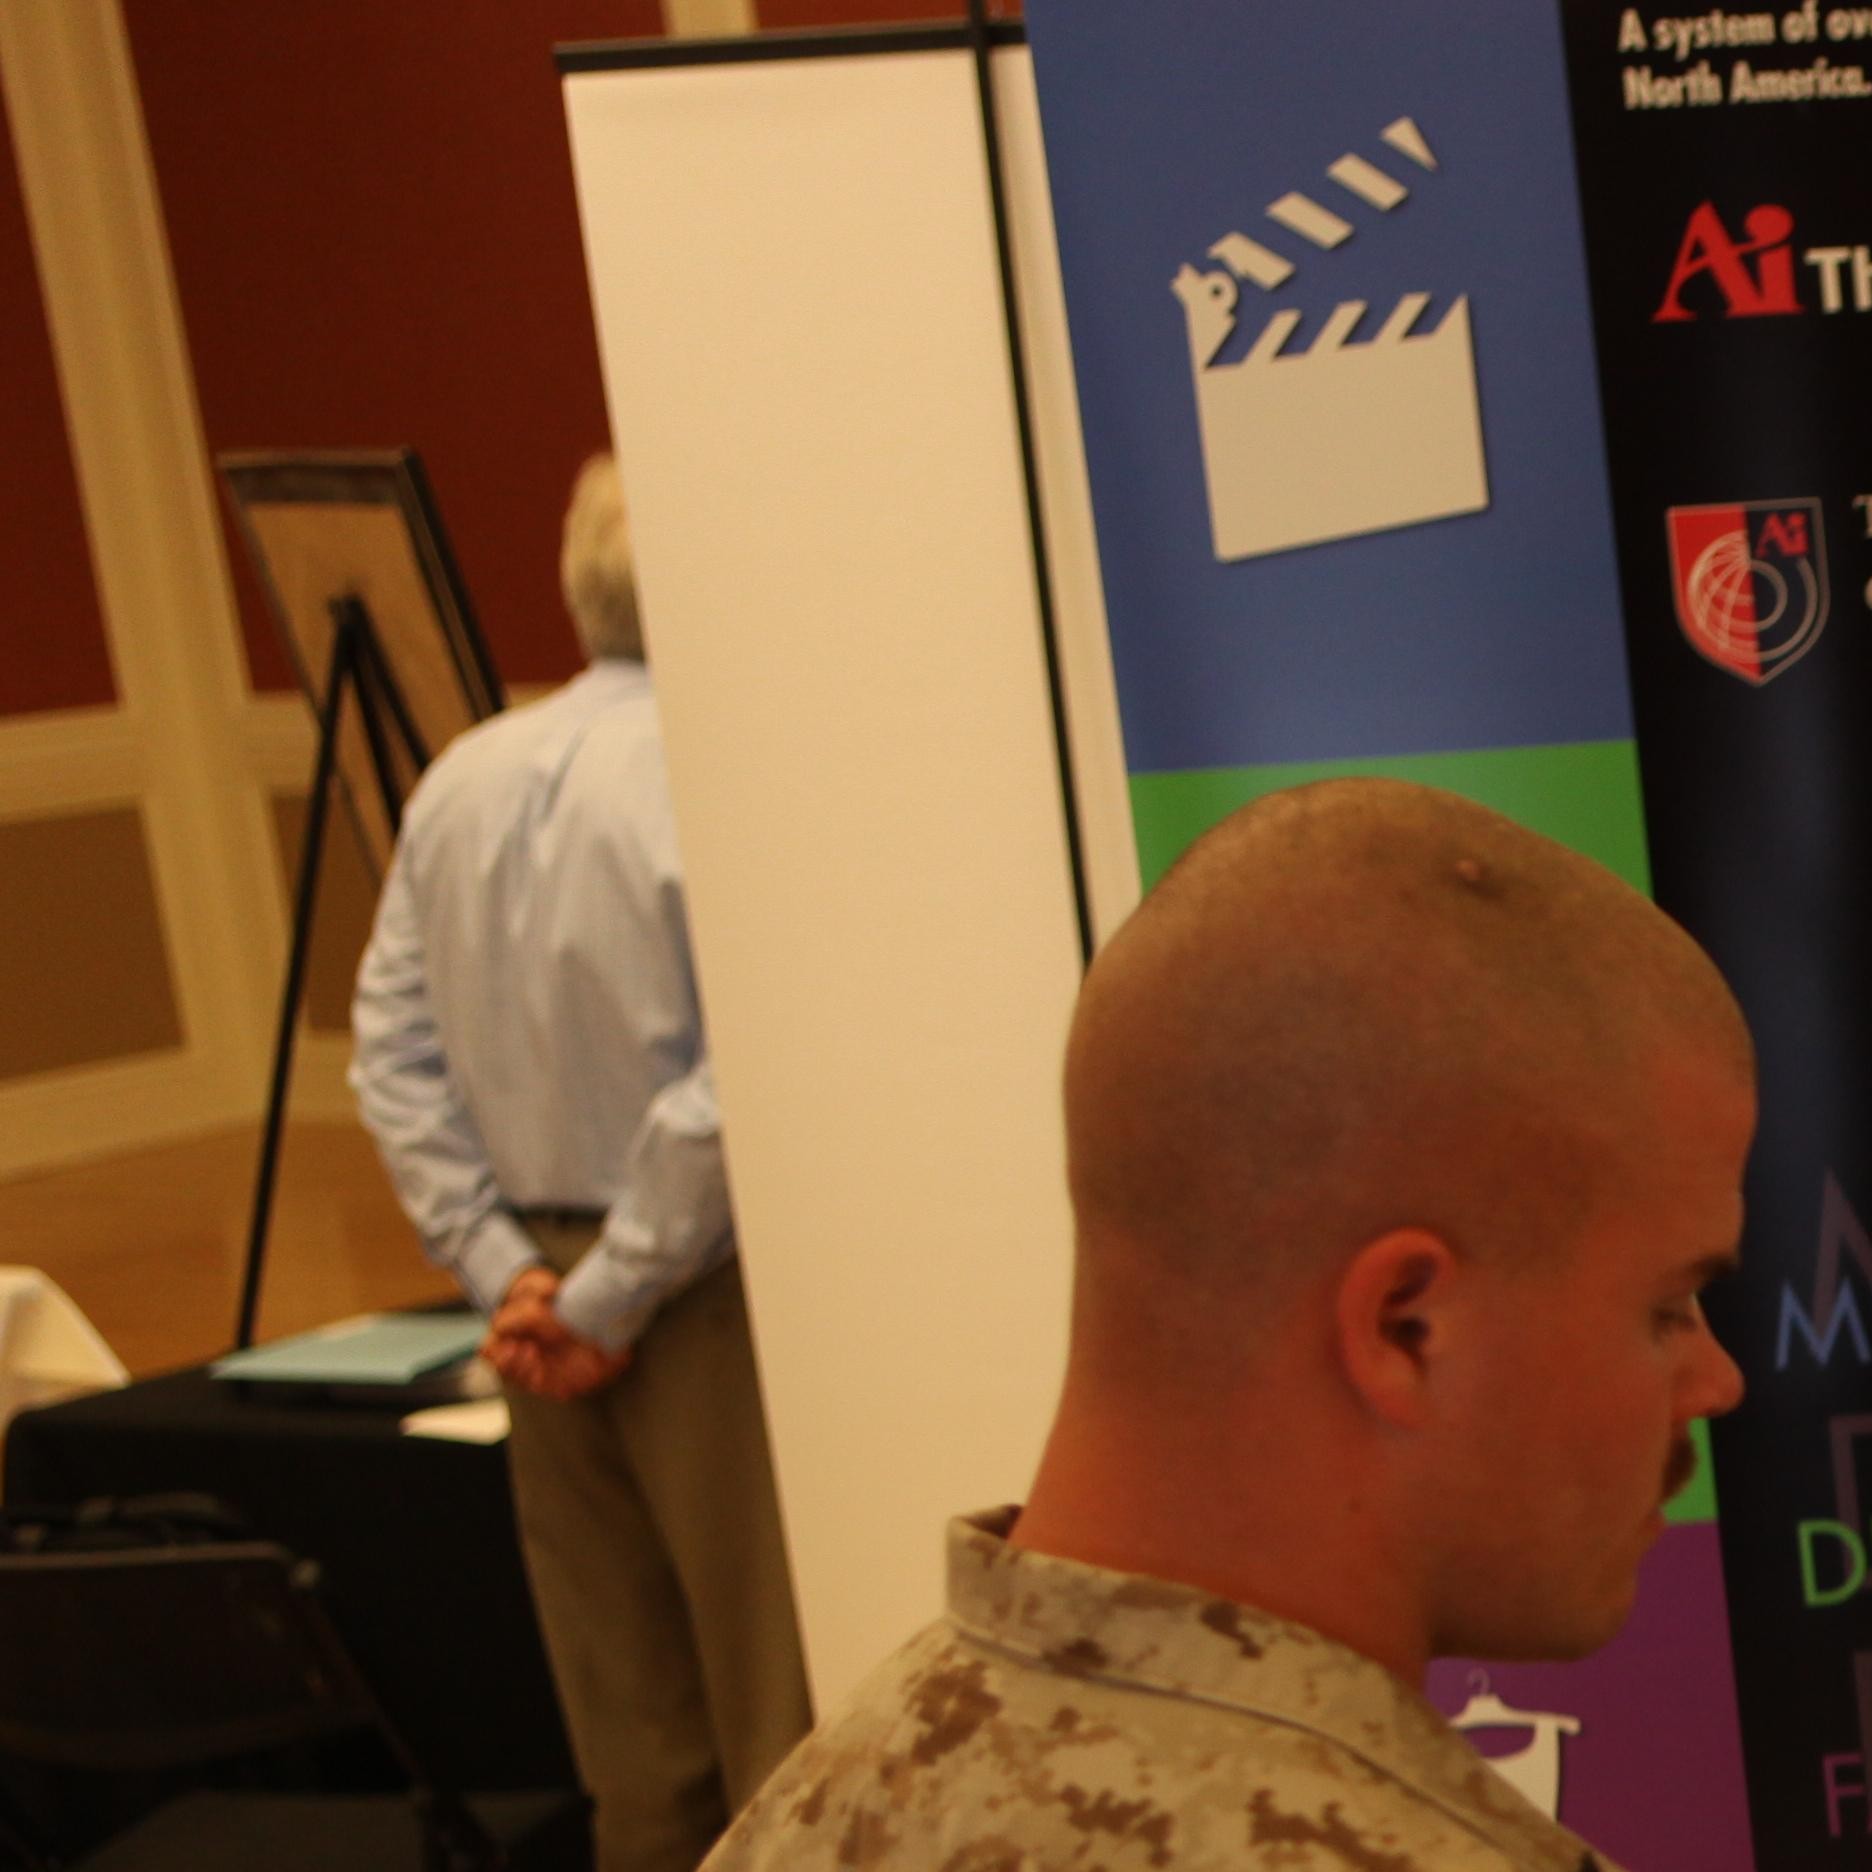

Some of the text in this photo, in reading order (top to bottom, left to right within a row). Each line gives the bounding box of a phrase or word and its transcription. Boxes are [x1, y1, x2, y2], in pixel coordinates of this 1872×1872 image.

[1617, 8, 1647, 53] A
[1653, 9, 1776, 61] system
[1782, 2, 1821, 46] of
[1622, 60, 1723, 110] North
[1652, 200, 1805, 322] Ai
